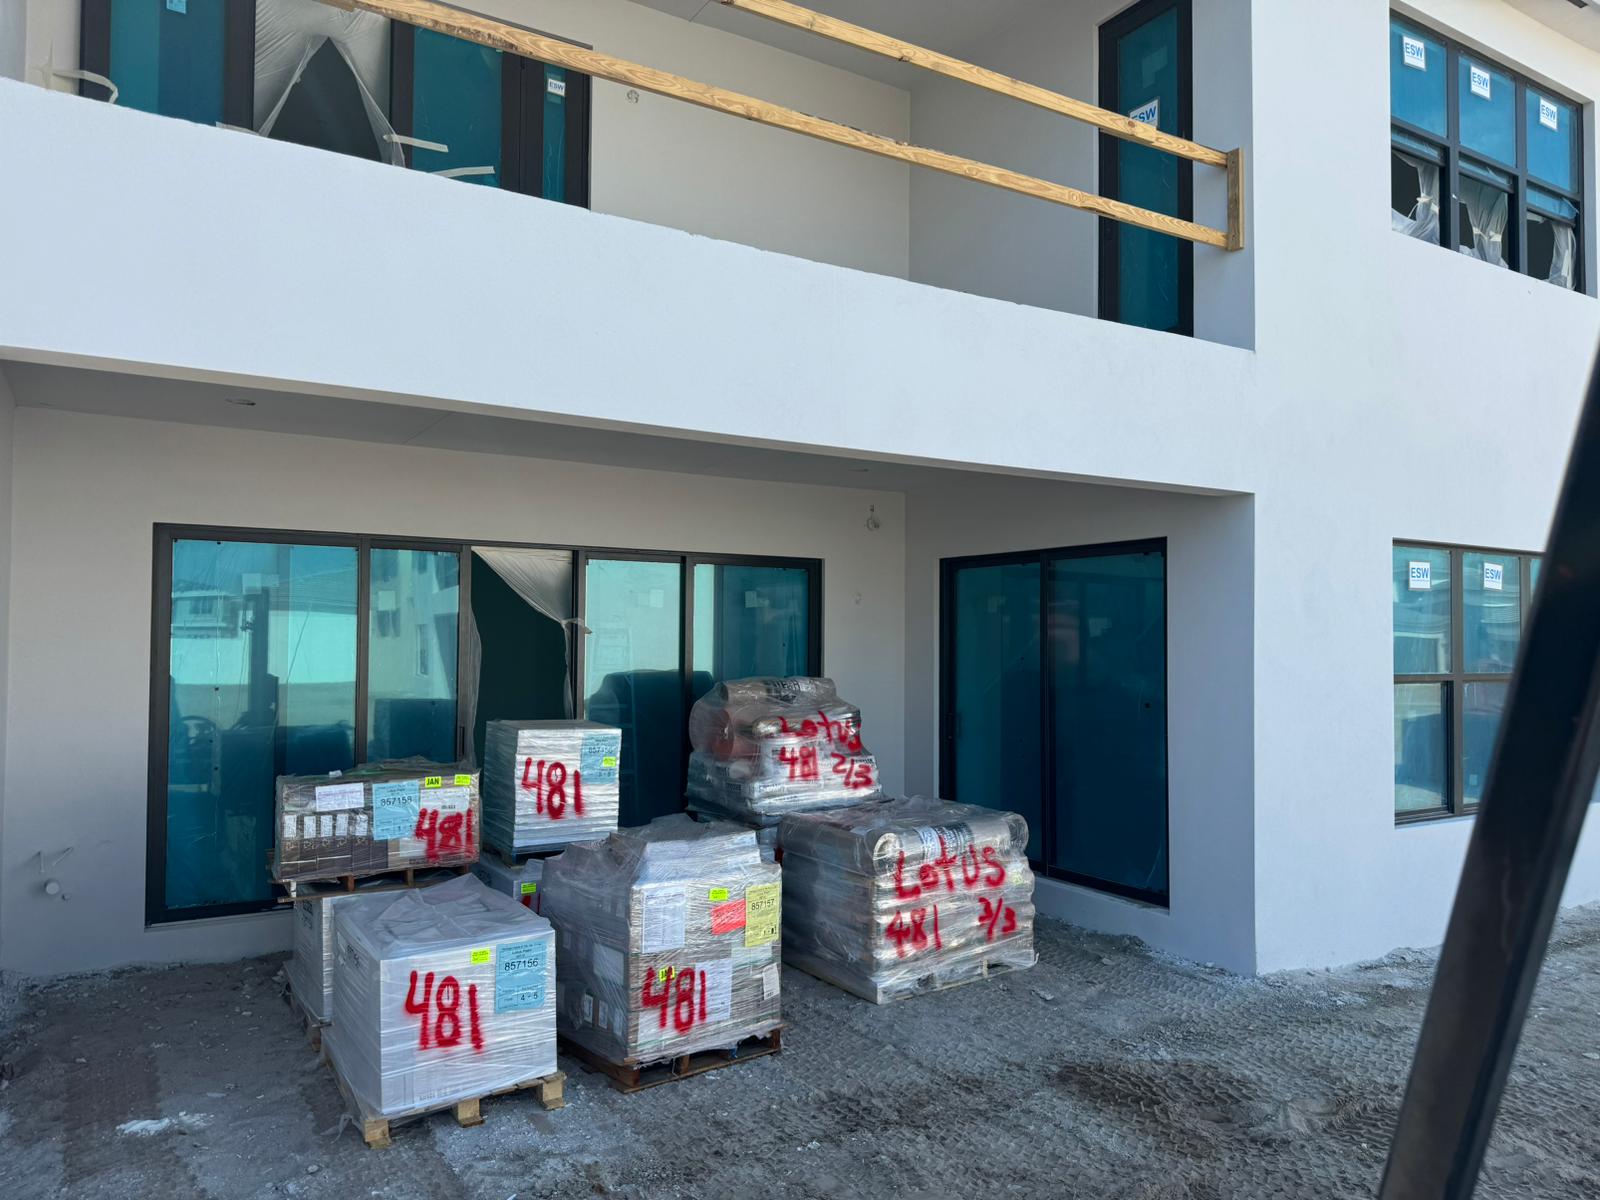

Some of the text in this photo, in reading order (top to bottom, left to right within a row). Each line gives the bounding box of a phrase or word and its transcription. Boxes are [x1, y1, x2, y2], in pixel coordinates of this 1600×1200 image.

[1405, 43, 1423, 58] ESW
[549, 81, 564, 90] ESW
[1472, 72, 1489, 88] ESW
[1541, 104, 1556, 119] ESW
[1411, 567, 1429, 578] ESW
[1485, 568, 1501, 580] ESW
[777, 745, 876, 789] 481 2/3
[426, 777, 440, 786] JAN
[521, 756, 585, 820] 481
[415, 807, 474, 865] 481
[751, 898, 775, 911] 857157
[885, 904, 942, 959] 481
[504, 958, 539, 972] 857156
[641, 965, 708, 1036] 481
[404, 970, 485, 1053] 481
